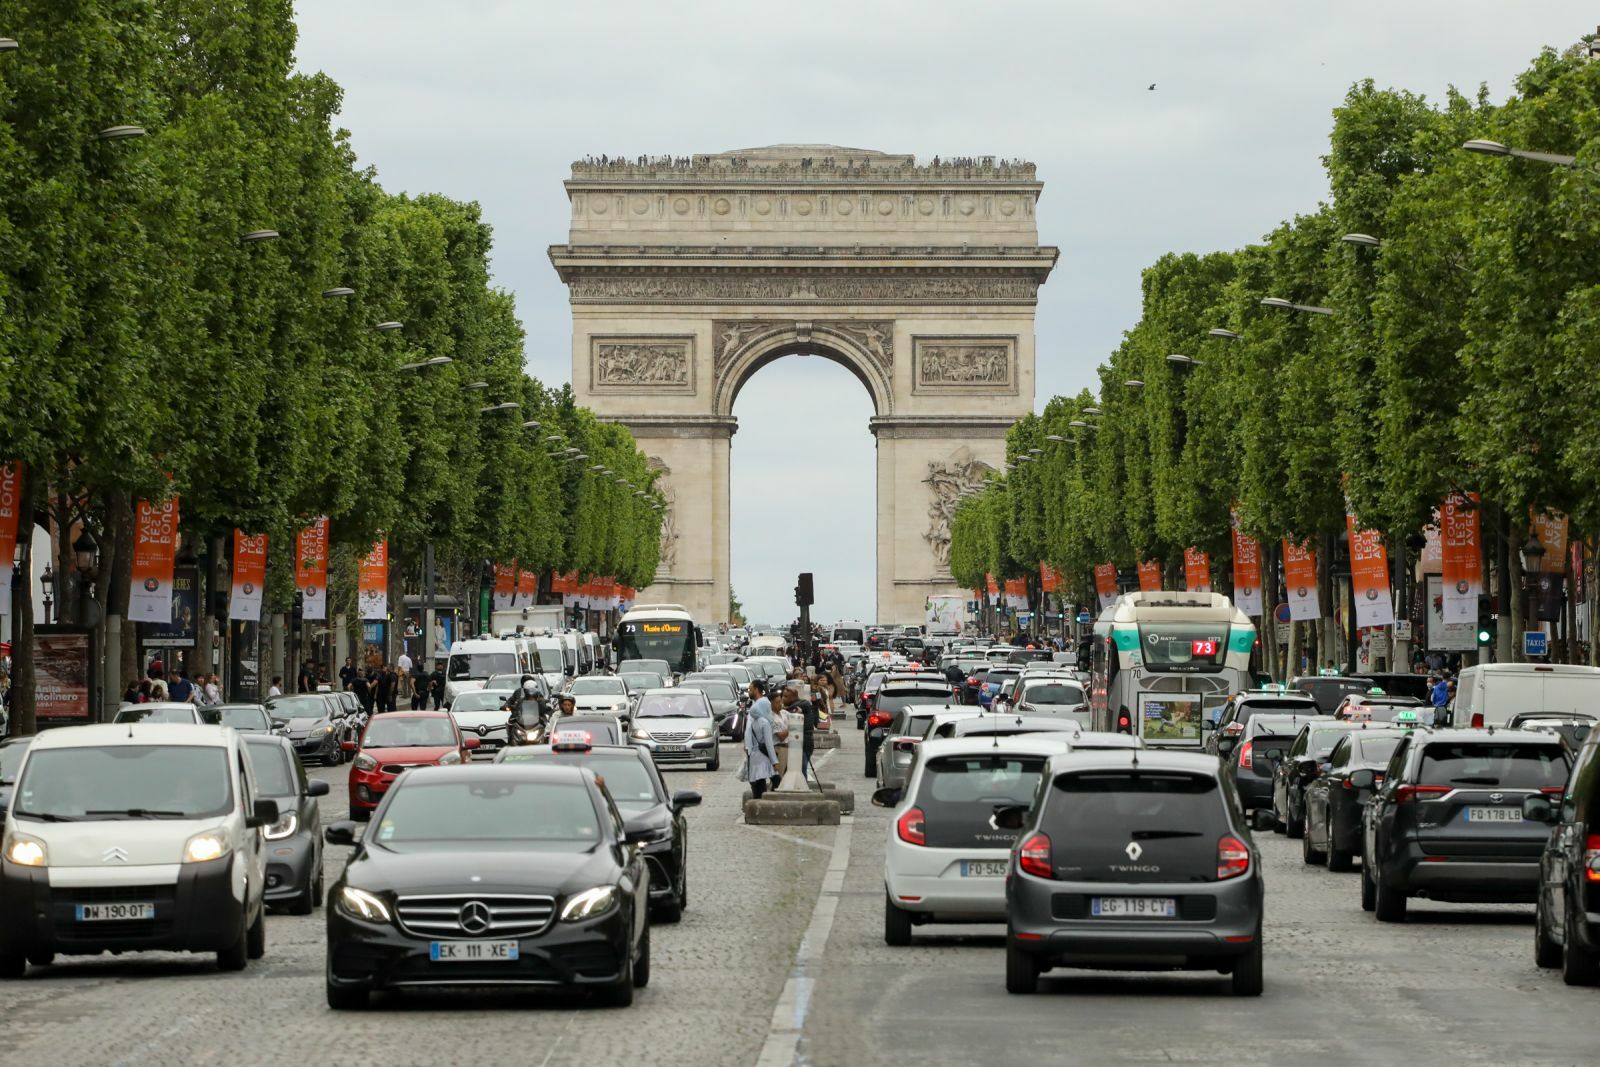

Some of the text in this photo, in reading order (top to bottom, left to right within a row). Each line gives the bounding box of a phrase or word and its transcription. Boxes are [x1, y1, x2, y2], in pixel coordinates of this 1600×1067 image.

[1445, 495, 1455, 546] BOUGE
[1196, 642, 1212, 653] 73
[1526, 639, 1545, 647] TAXIS
[1133, 669, 1141, 679] 70
[35, 693, 78, 701] Molinero
